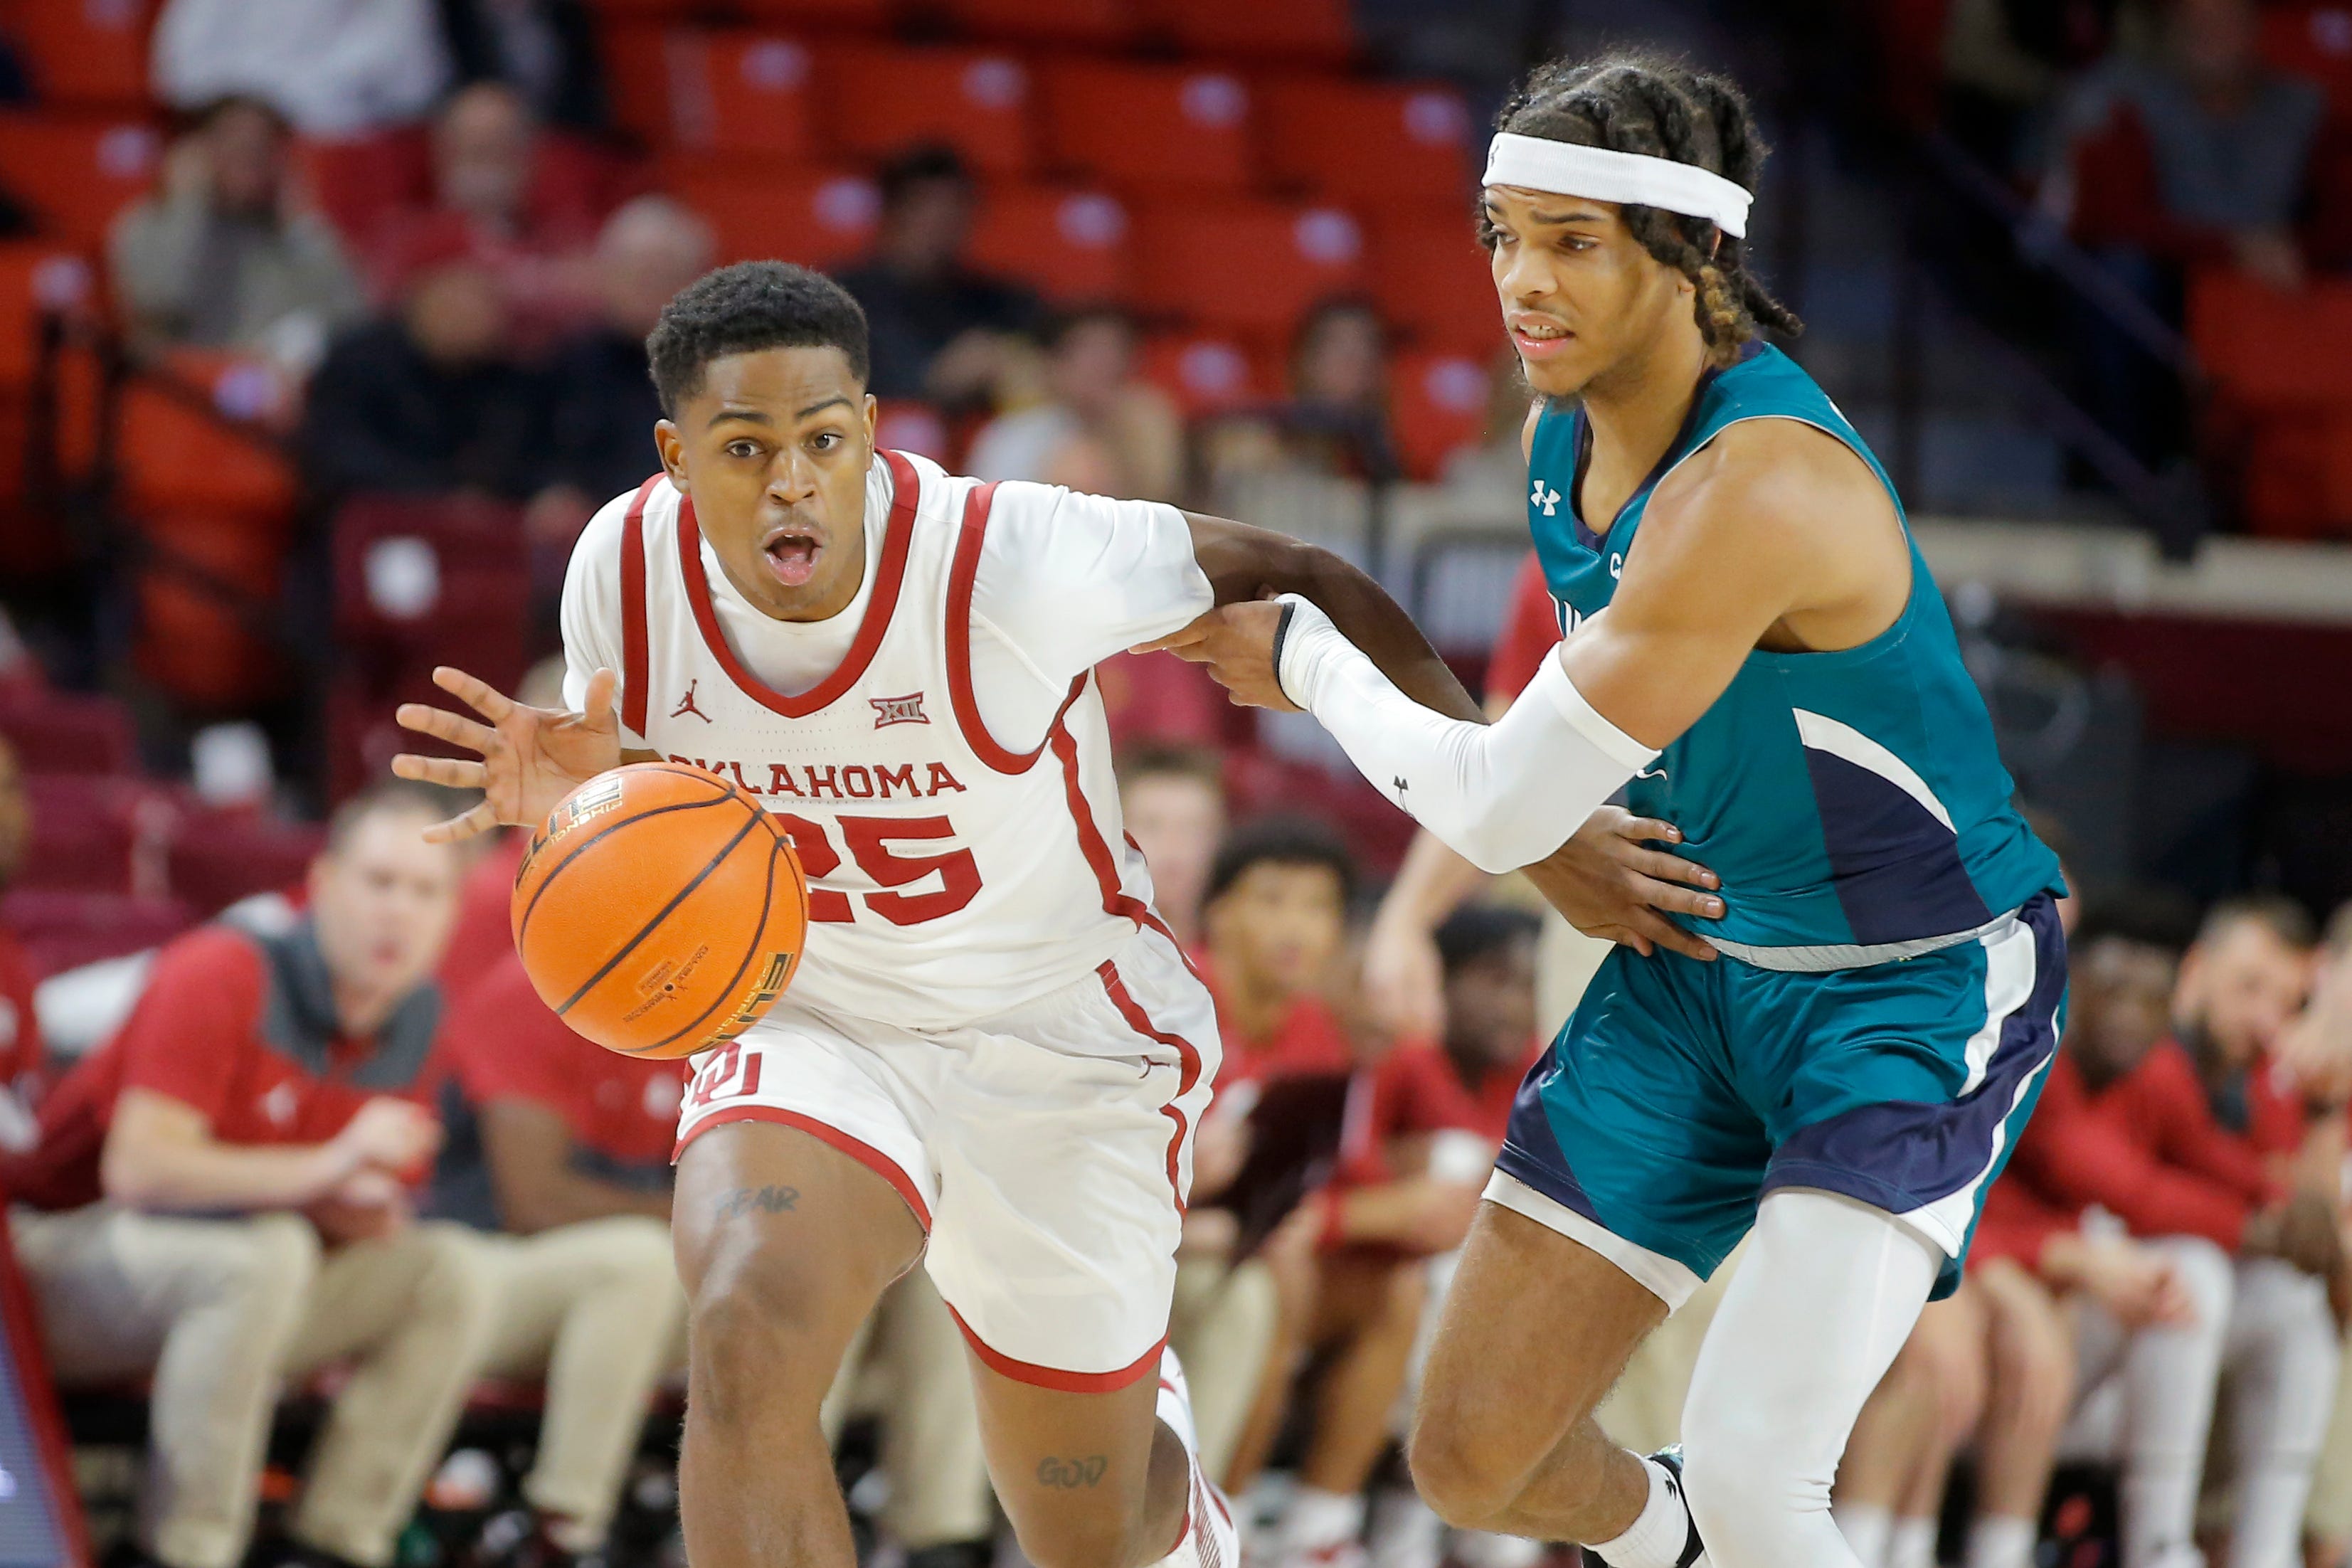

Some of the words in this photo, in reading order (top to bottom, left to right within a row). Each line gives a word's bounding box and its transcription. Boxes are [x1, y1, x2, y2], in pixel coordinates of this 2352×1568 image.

[868, 692, 931, 729] XII
[668, 753, 966, 799] LAHOMA
[714, 1185, 802, 1222] FEAR
[1036, 1456, 1108, 1489] GOD
